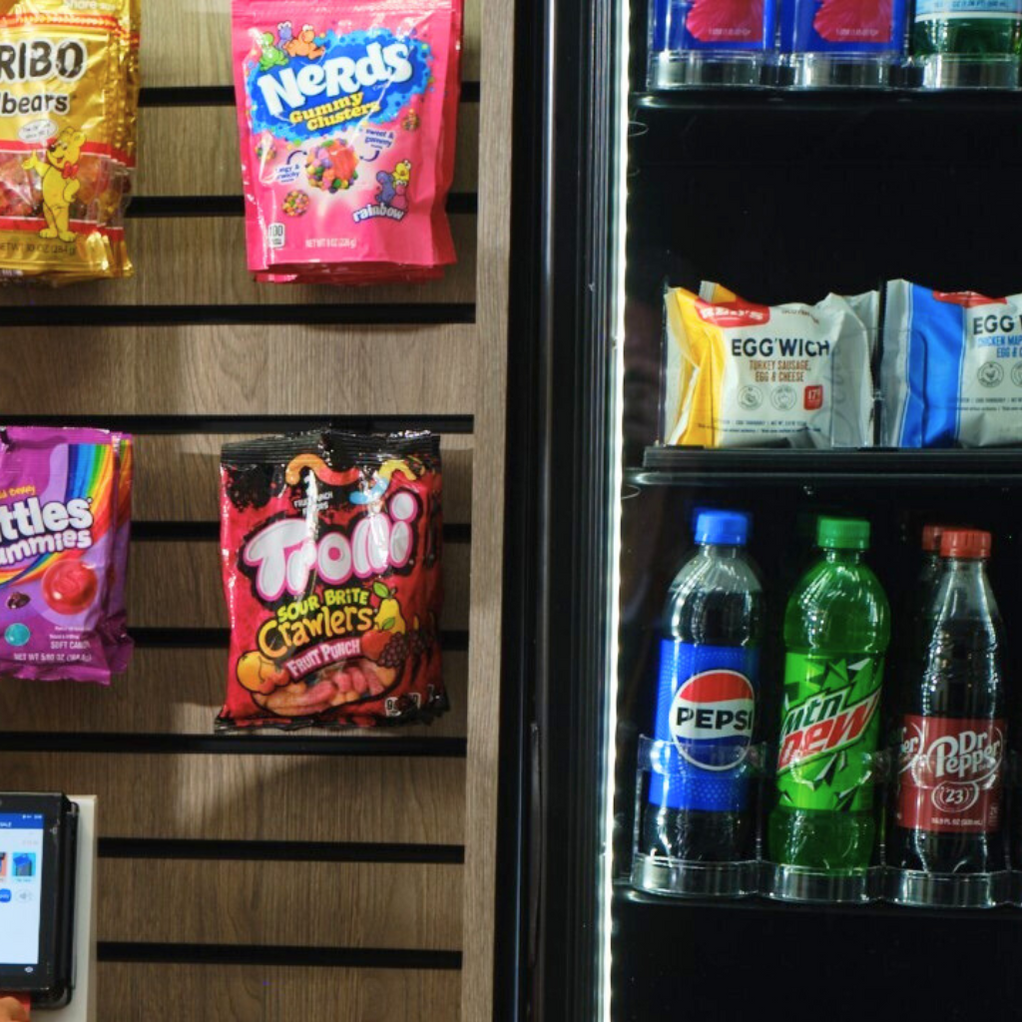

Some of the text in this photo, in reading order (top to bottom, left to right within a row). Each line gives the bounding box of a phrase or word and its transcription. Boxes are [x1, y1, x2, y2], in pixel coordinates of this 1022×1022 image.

[307, 101, 382, 131] Clusters
[353, 203, 404, 223] rainbow
[244, 491, 414, 600] Trolli
[277, 594, 320, 624] SOUR
[258, 605, 374, 660] Crawlers
[287, 638, 362, 677] FRUIT PUNCH
[676, 706, 753, 731] PEPSI
[927, 735, 1001, 778] Pepper
[959, 730, 988, 756] Dr
[945, 788, 964, 804] 23
